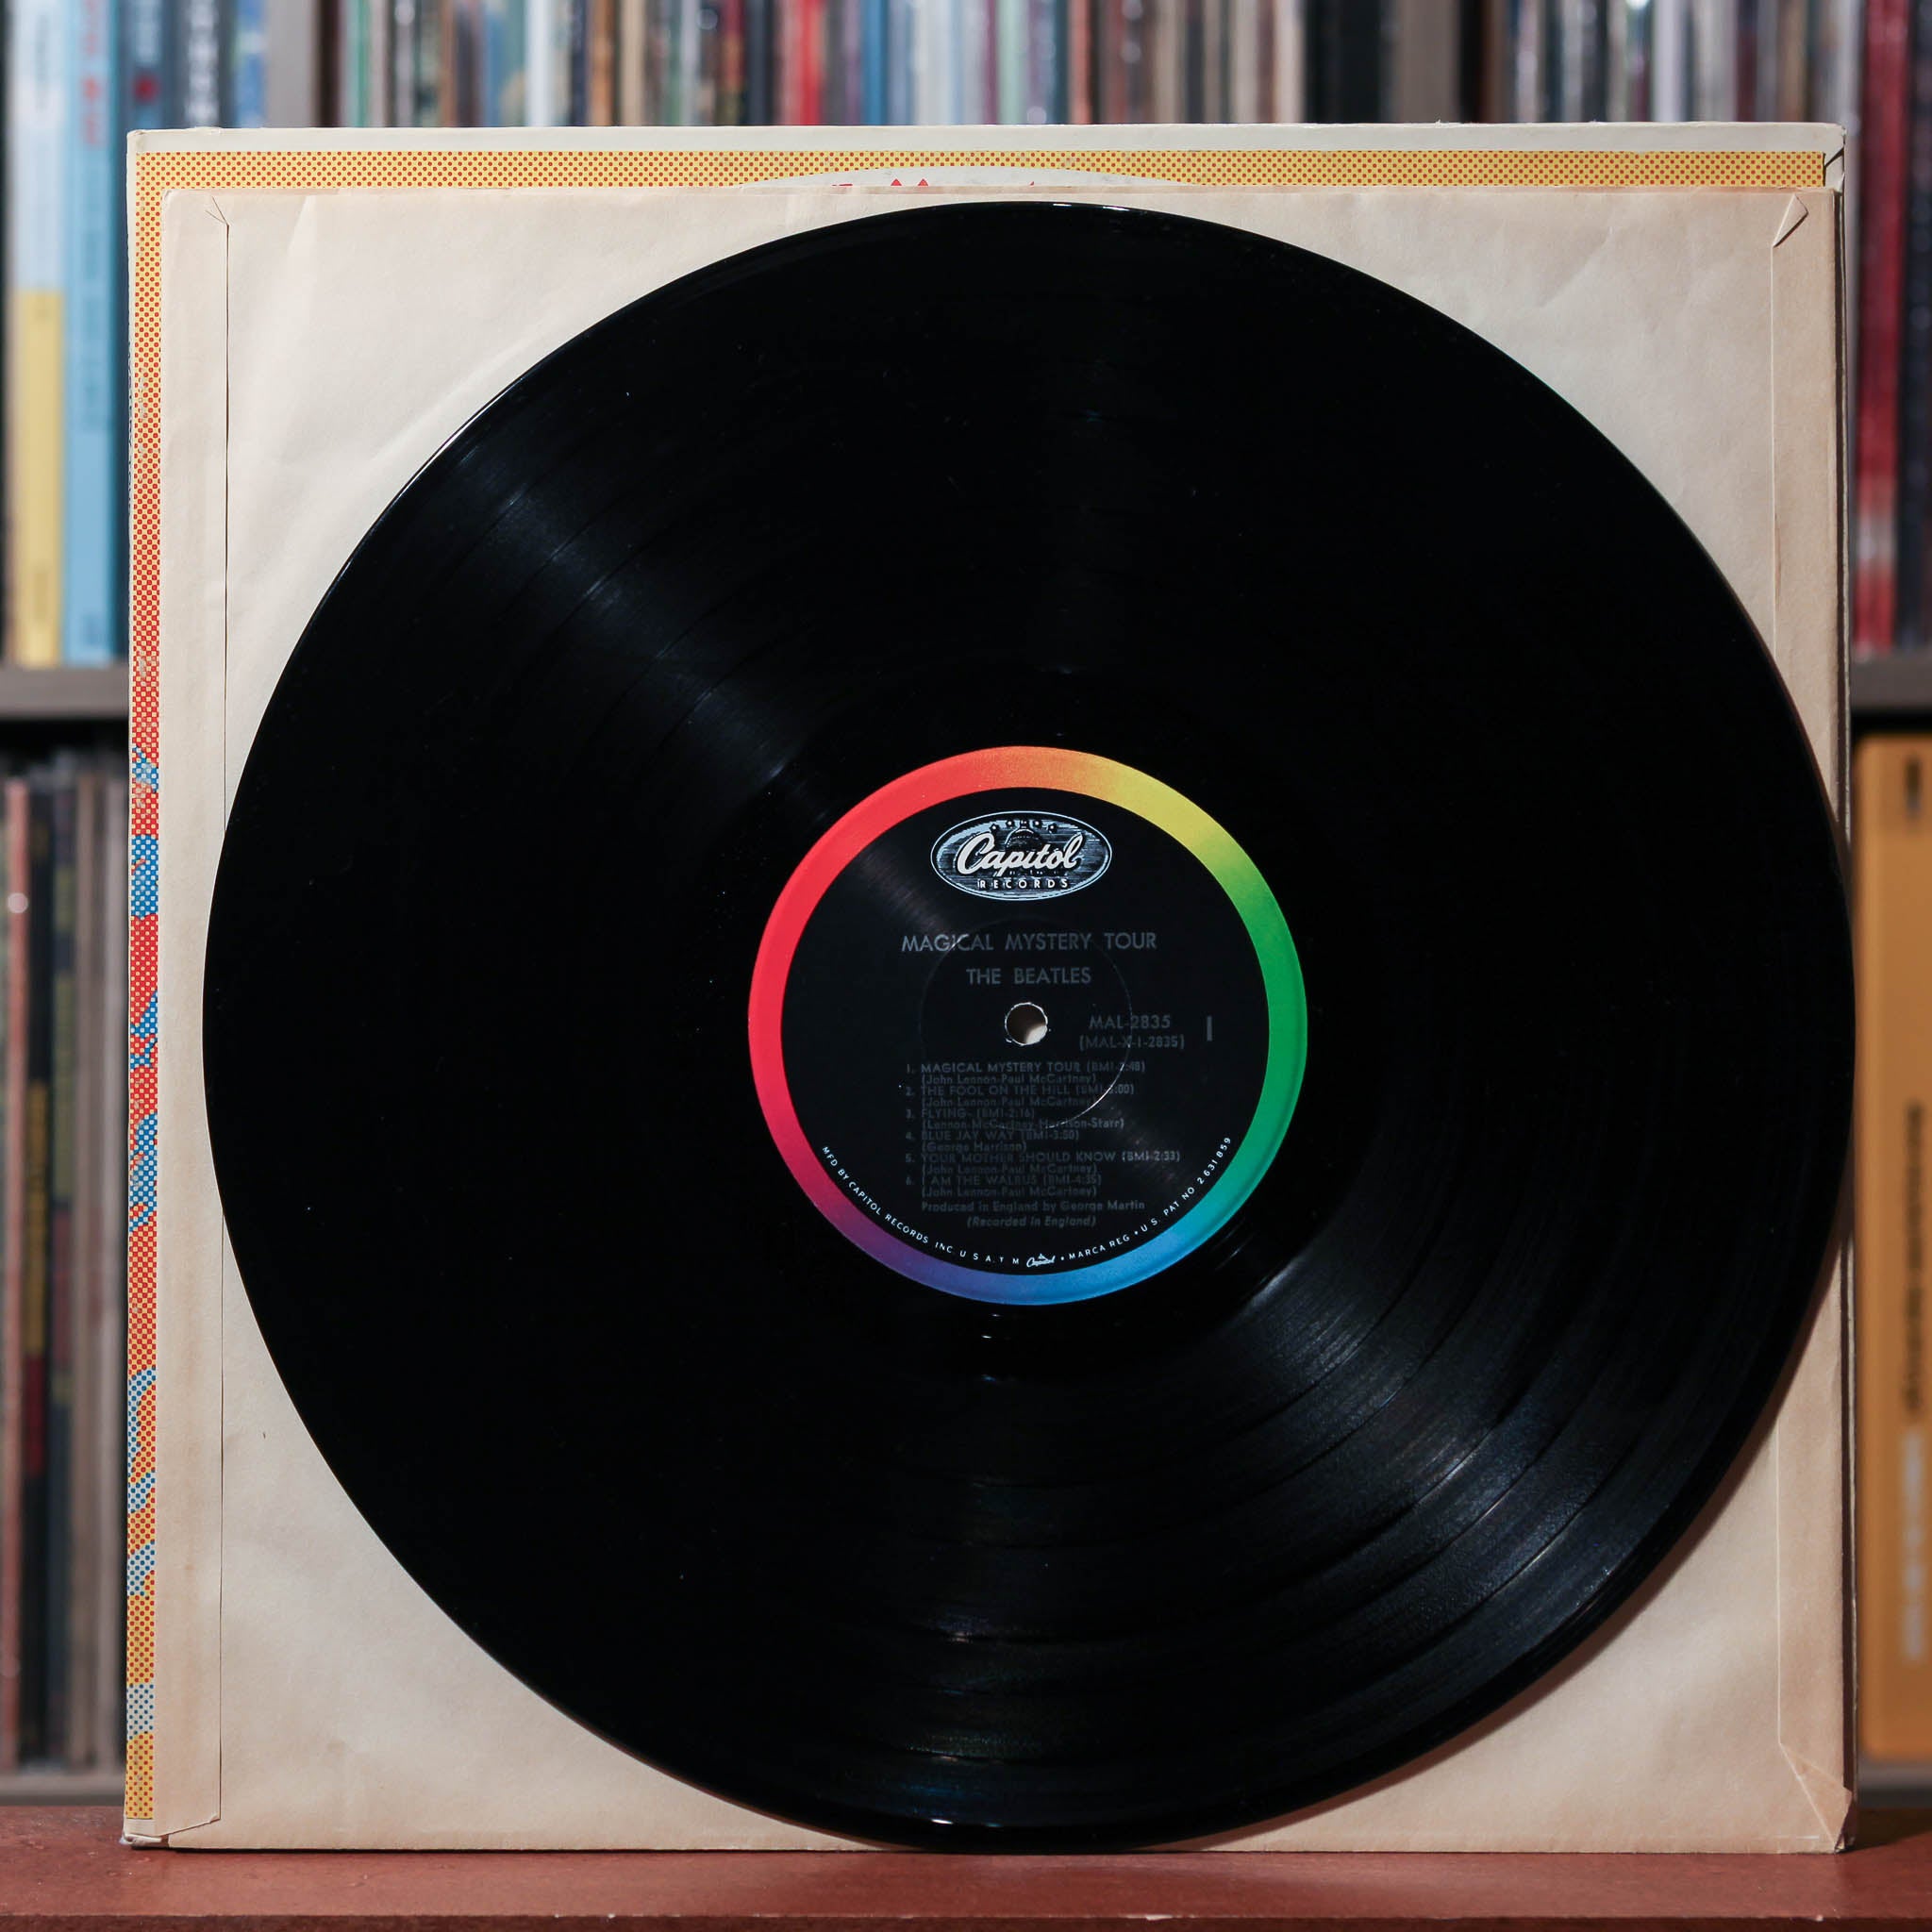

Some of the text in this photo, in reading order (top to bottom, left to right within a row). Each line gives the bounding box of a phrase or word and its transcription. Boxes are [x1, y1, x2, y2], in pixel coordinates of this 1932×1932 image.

[957, 831, 1083, 876] Capitol
[977, 878, 1068, 889] RECORDS
[901, 932, 1158, 952] MAGICAL MYSTERY TOUR
[966, 966, 1092, 985] THE BEATLES
[1089, 1013, 1170, 1029] MAL-2835
[922, 1062, 982, 1073] MAGICAL
[988, 1062, 1041, 1072] MYSTERY
[1046, 1060, 1081, 1072] TOUR
[922, 1086, 943, 1095] THE
[949, 1085, 983, 1095] FOOL
[989, 1085, 1008, 1095] ON
[1014, 1085, 1037, 1094] THE
[1075, 1151, 1116, 1161] KNOW
[823, 1146, 838, 1166] MFD
[838, 1168, 850, 1180] BY
[849, 1181, 881, 1215] CAPITOL
[885, 1213, 928, 1243] RECORDS
[935, 1241, 953, 1253] INC
[1069, 1244, 1106, 1260] MARCA
[1108, 1234, 1130, 1247] REG
[1163, 1201, 1179, 1216] PAT
[1181, 1187, 1195, 1200] NO
[1107, 1199, 1145, 1211] Martin
